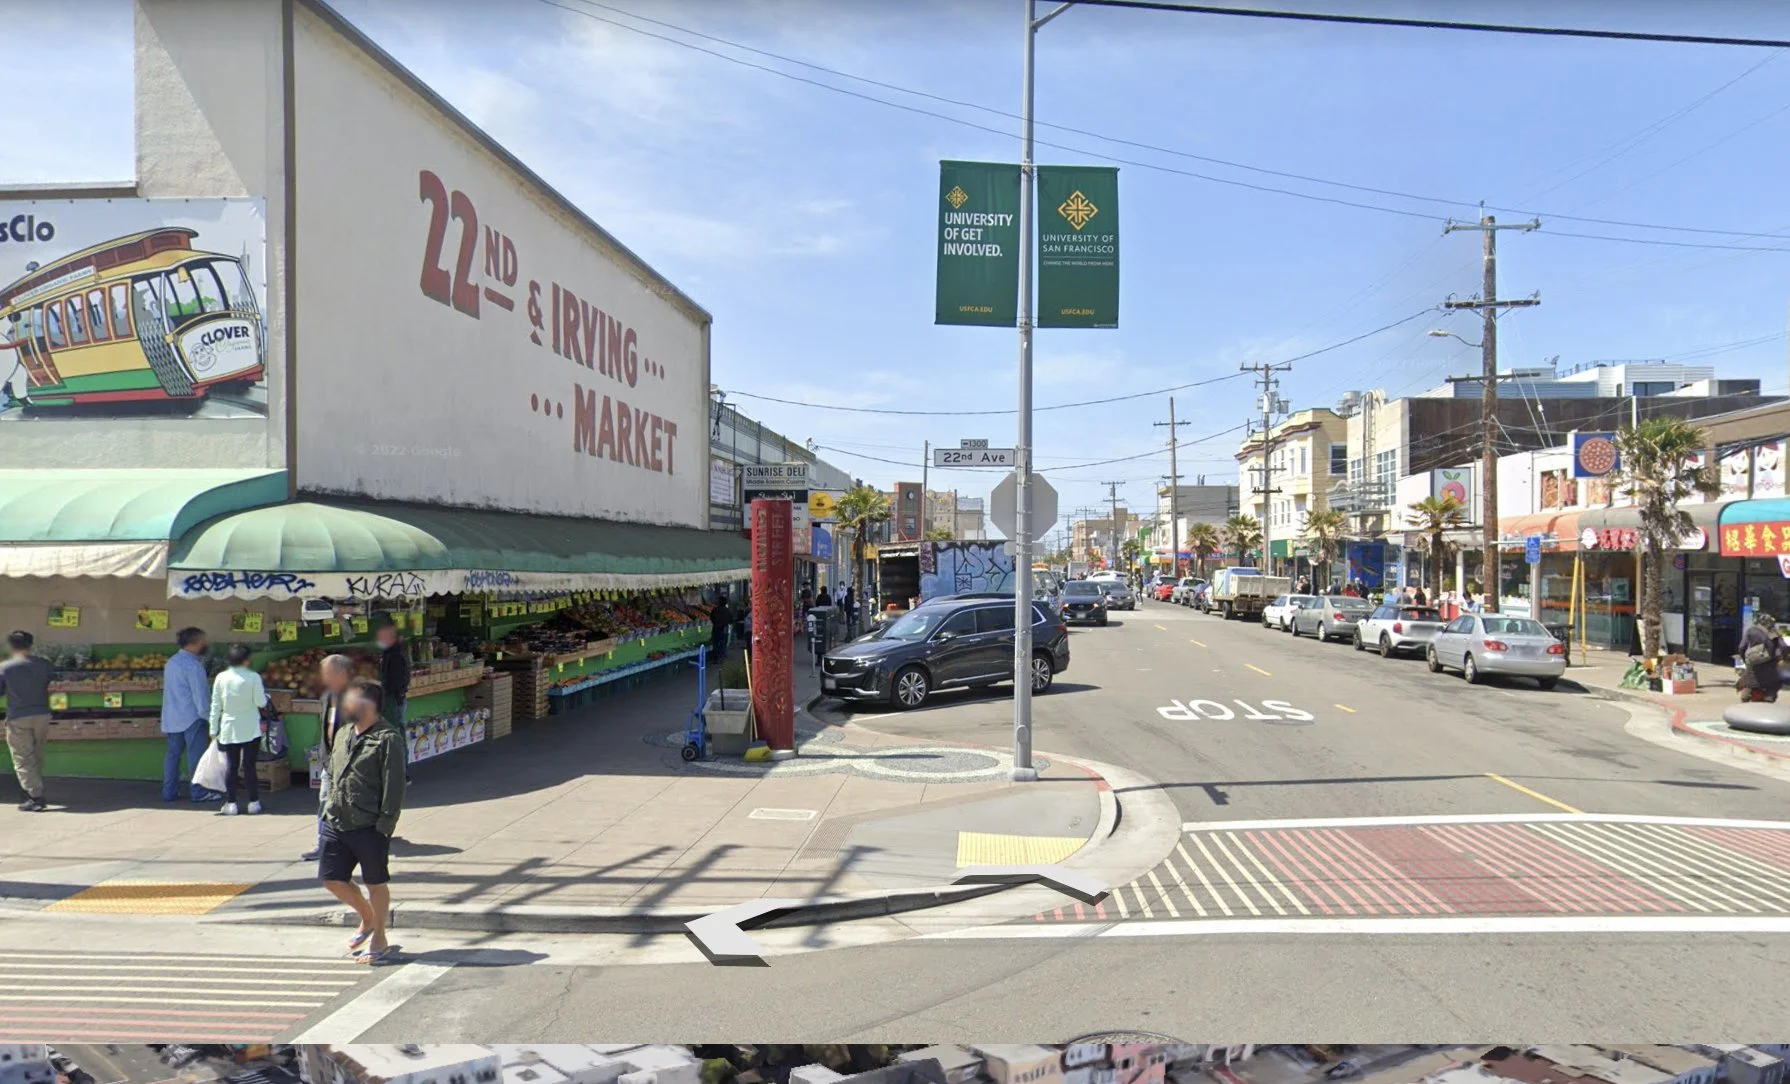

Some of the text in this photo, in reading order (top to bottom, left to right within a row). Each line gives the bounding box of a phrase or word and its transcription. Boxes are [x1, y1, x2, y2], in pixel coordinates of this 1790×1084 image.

[944, 212, 1013, 226] UNIVERSITY
[944, 227, 983, 240] OF GET
[1043, 234, 1099, 242] UNIVERSITY
[943, 243, 1003, 257] INVOLVED.
[1043, 244, 1114, 253] SAN FRANCISCO
[527, 279, 545, 347] &
[201, 326, 250, 346] CLOVER
[969, 440, 987, 448] 1300
[943, 452, 1006, 463] 22nd Ave
[746, 467, 806, 477] SUNRISE DELI
[1156, 699, 1314, 721] STOP
